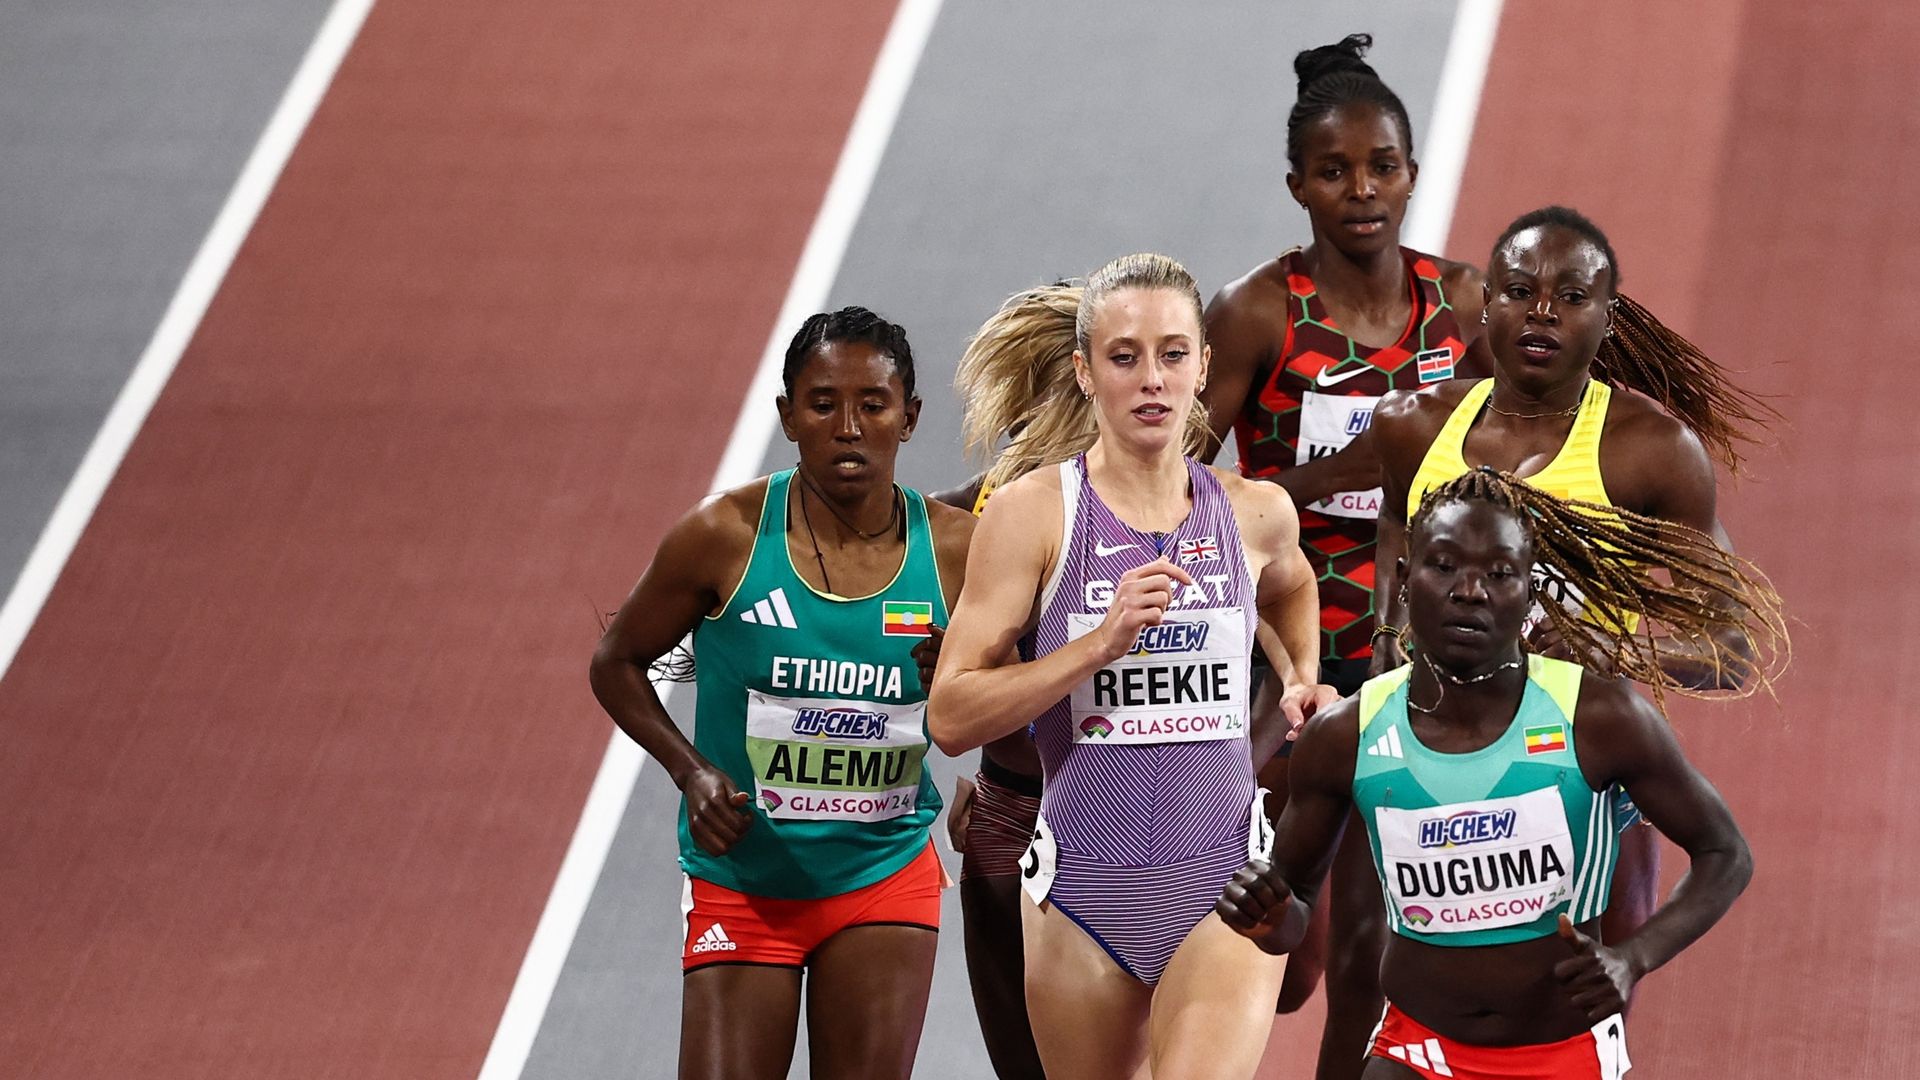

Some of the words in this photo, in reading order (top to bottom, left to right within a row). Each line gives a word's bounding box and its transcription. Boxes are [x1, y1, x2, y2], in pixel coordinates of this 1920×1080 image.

[1085, 574, 1229, 608] GAT
[1131, 621, 1209, 654] -CHEW
[771, 656, 902, 699] ETHIOPIA
[1093, 663, 1230, 707] REEKIE
[793, 708, 888, 740] HI-CHEW
[1122, 715, 1221, 735] GLASGOW
[1225, 713, 1242, 730] 24
[765, 744, 907, 787] ALEMU
[790, 796, 888, 814] GLASGOW
[891, 794, 910, 810] 24
[1418, 809, 1516, 848] HI-CHEW
[1396, 844, 1565, 898] DUGUMA
[1440, 895, 1544, 924] GLASGOW
[692, 940, 737, 953] adidas
